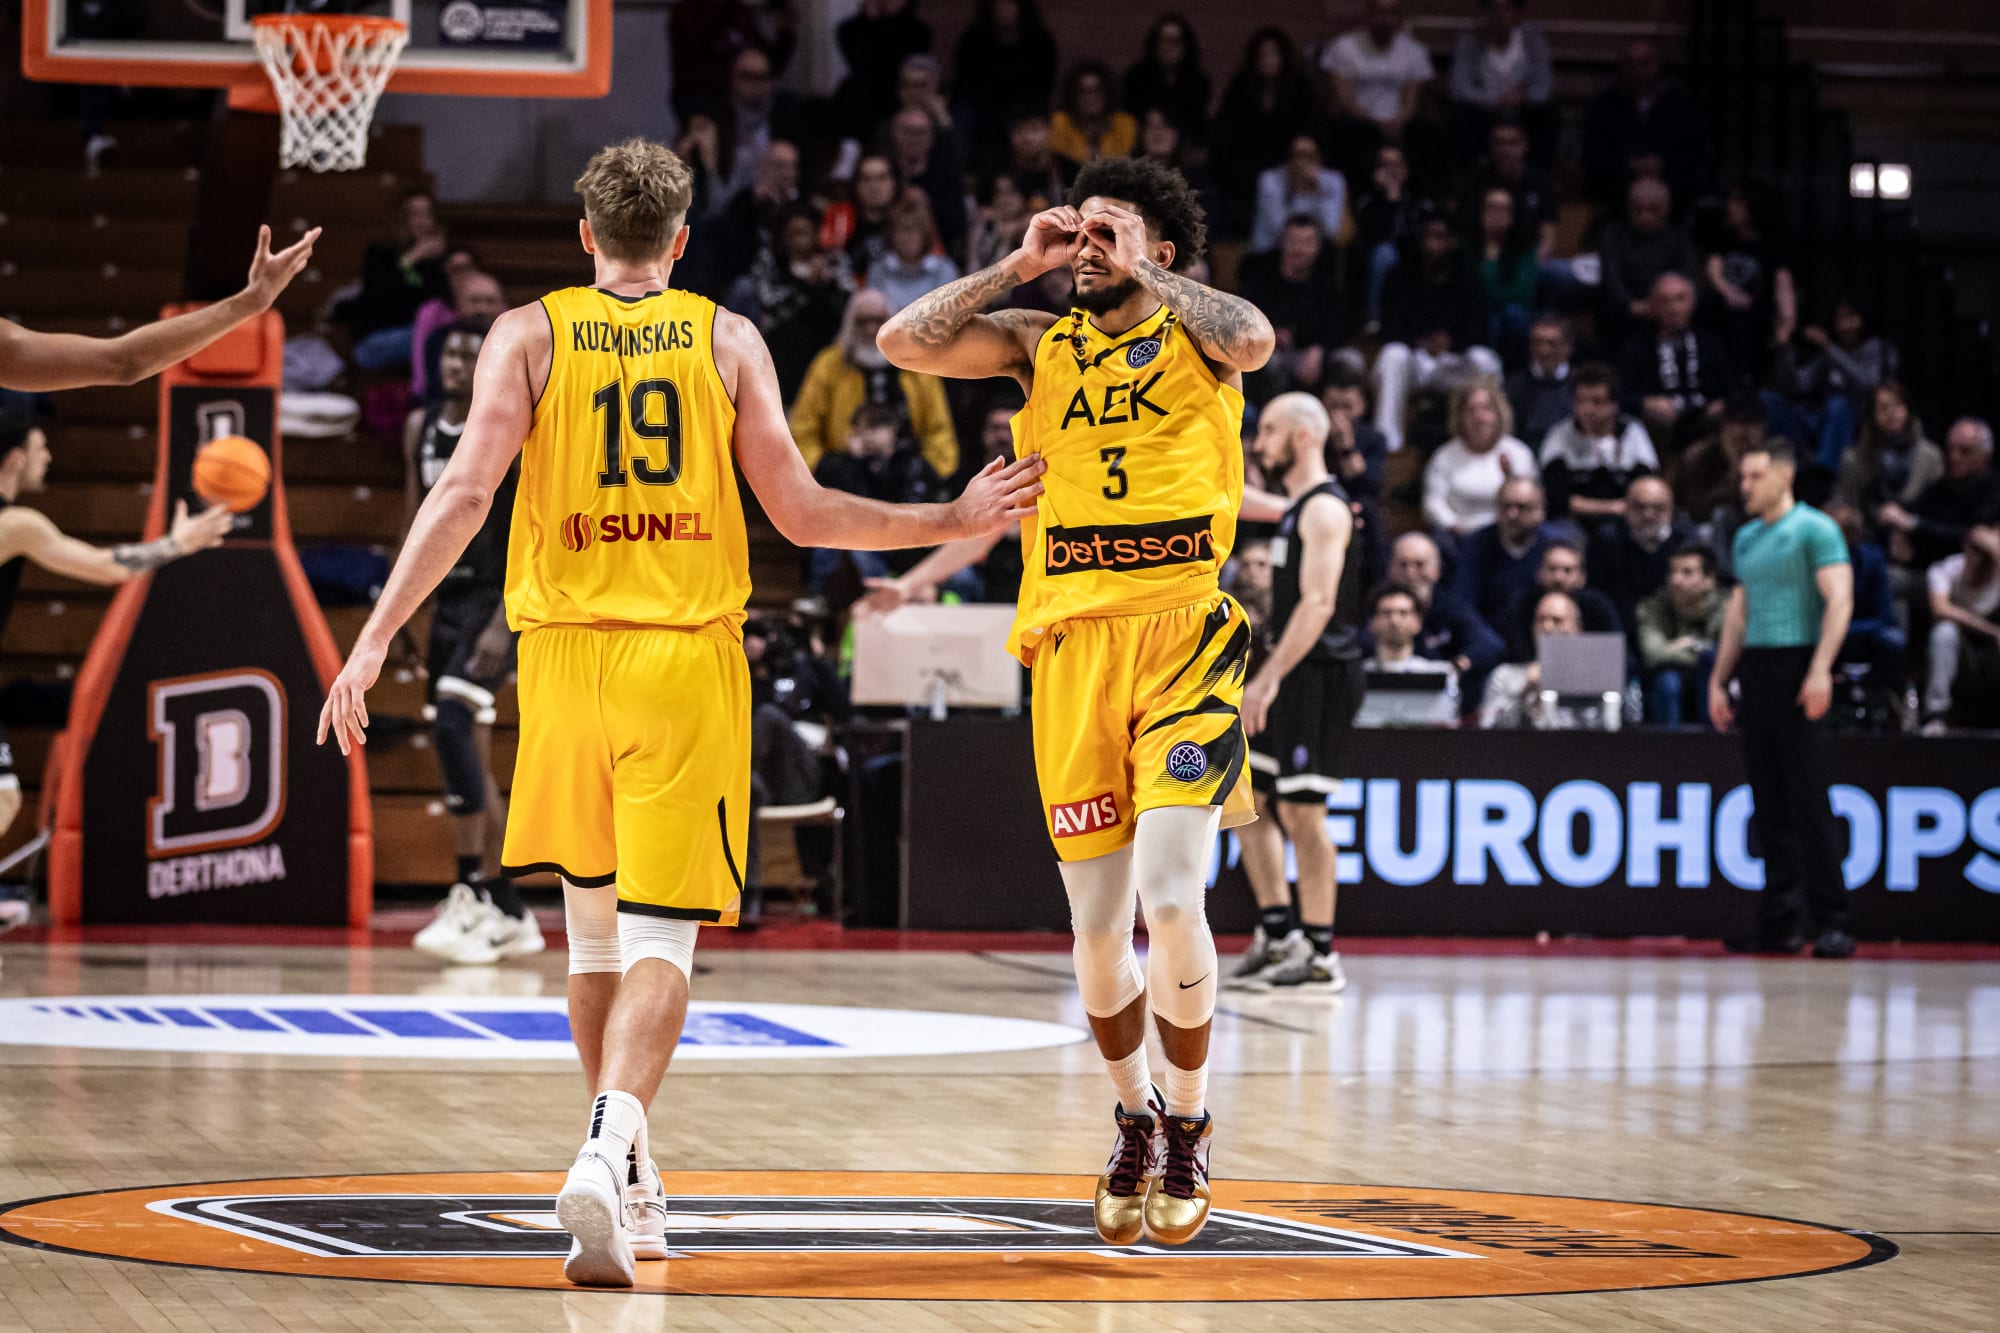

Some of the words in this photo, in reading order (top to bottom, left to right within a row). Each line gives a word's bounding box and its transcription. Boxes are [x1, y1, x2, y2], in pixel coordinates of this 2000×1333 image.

[572, 320, 693, 357] KUZMINSKAS
[1061, 371, 1171, 430] AEK
[593, 378, 683, 488] 19
[1100, 446, 1128, 500] 3
[600, 513, 712, 541] SUNEL
[1054, 797, 1117, 835] AVIS
[147, 844, 286, 899] DERTHONA
